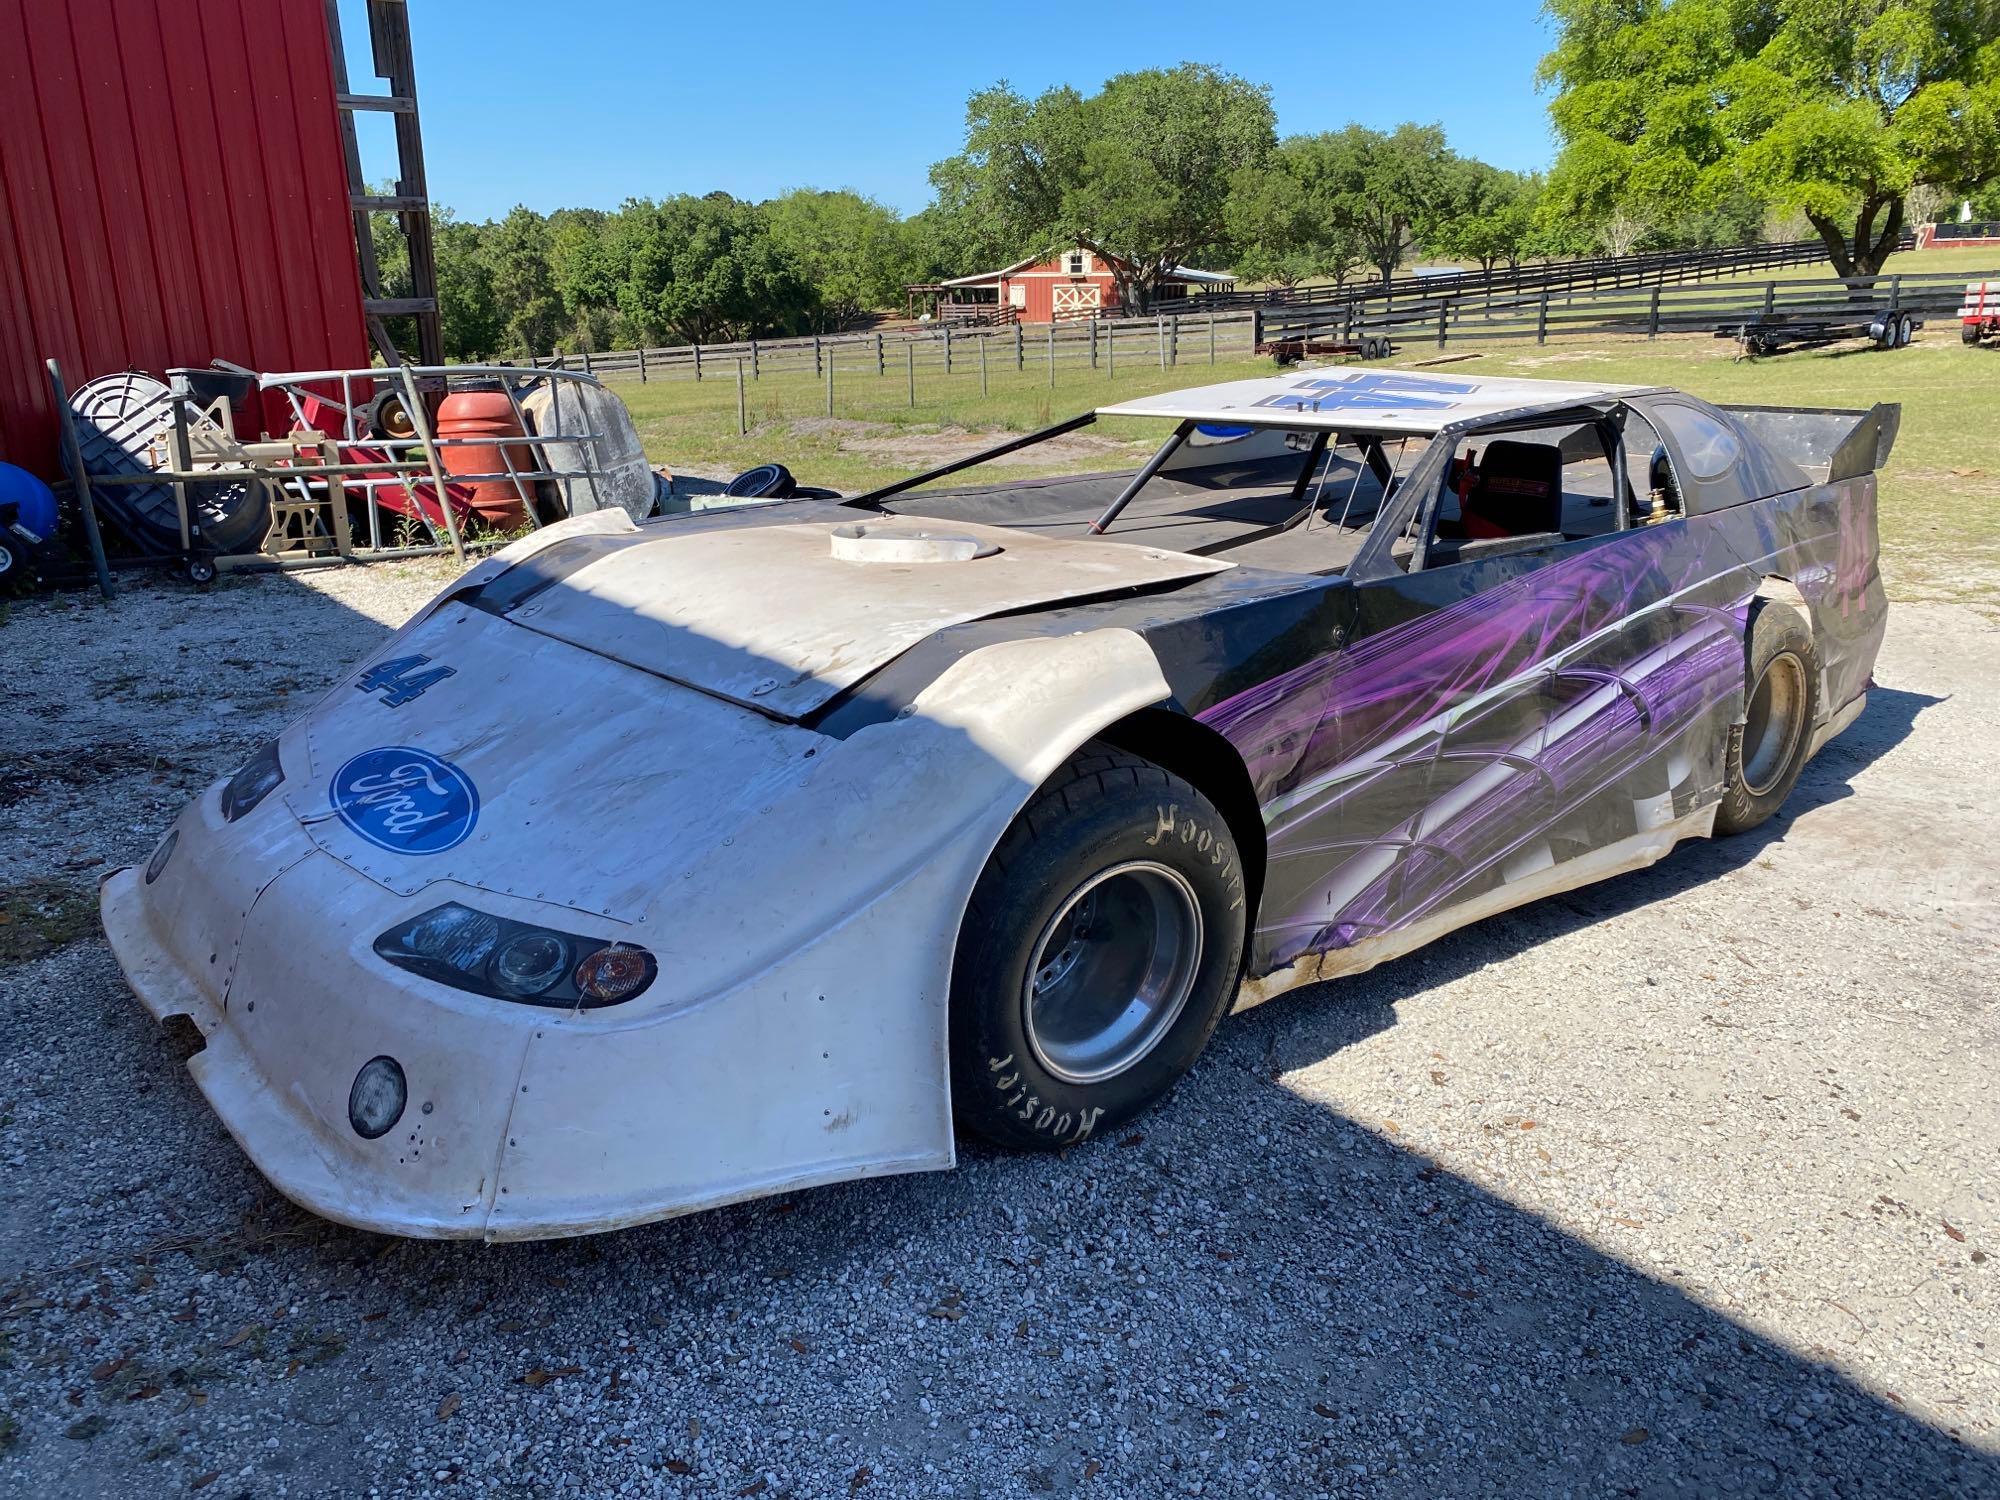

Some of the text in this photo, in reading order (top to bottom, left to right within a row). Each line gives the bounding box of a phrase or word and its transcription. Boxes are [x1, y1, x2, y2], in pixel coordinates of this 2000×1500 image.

[1250, 374, 1483, 410] 44
[354, 653, 457, 709] 44
[350, 763, 448, 834] Ford
